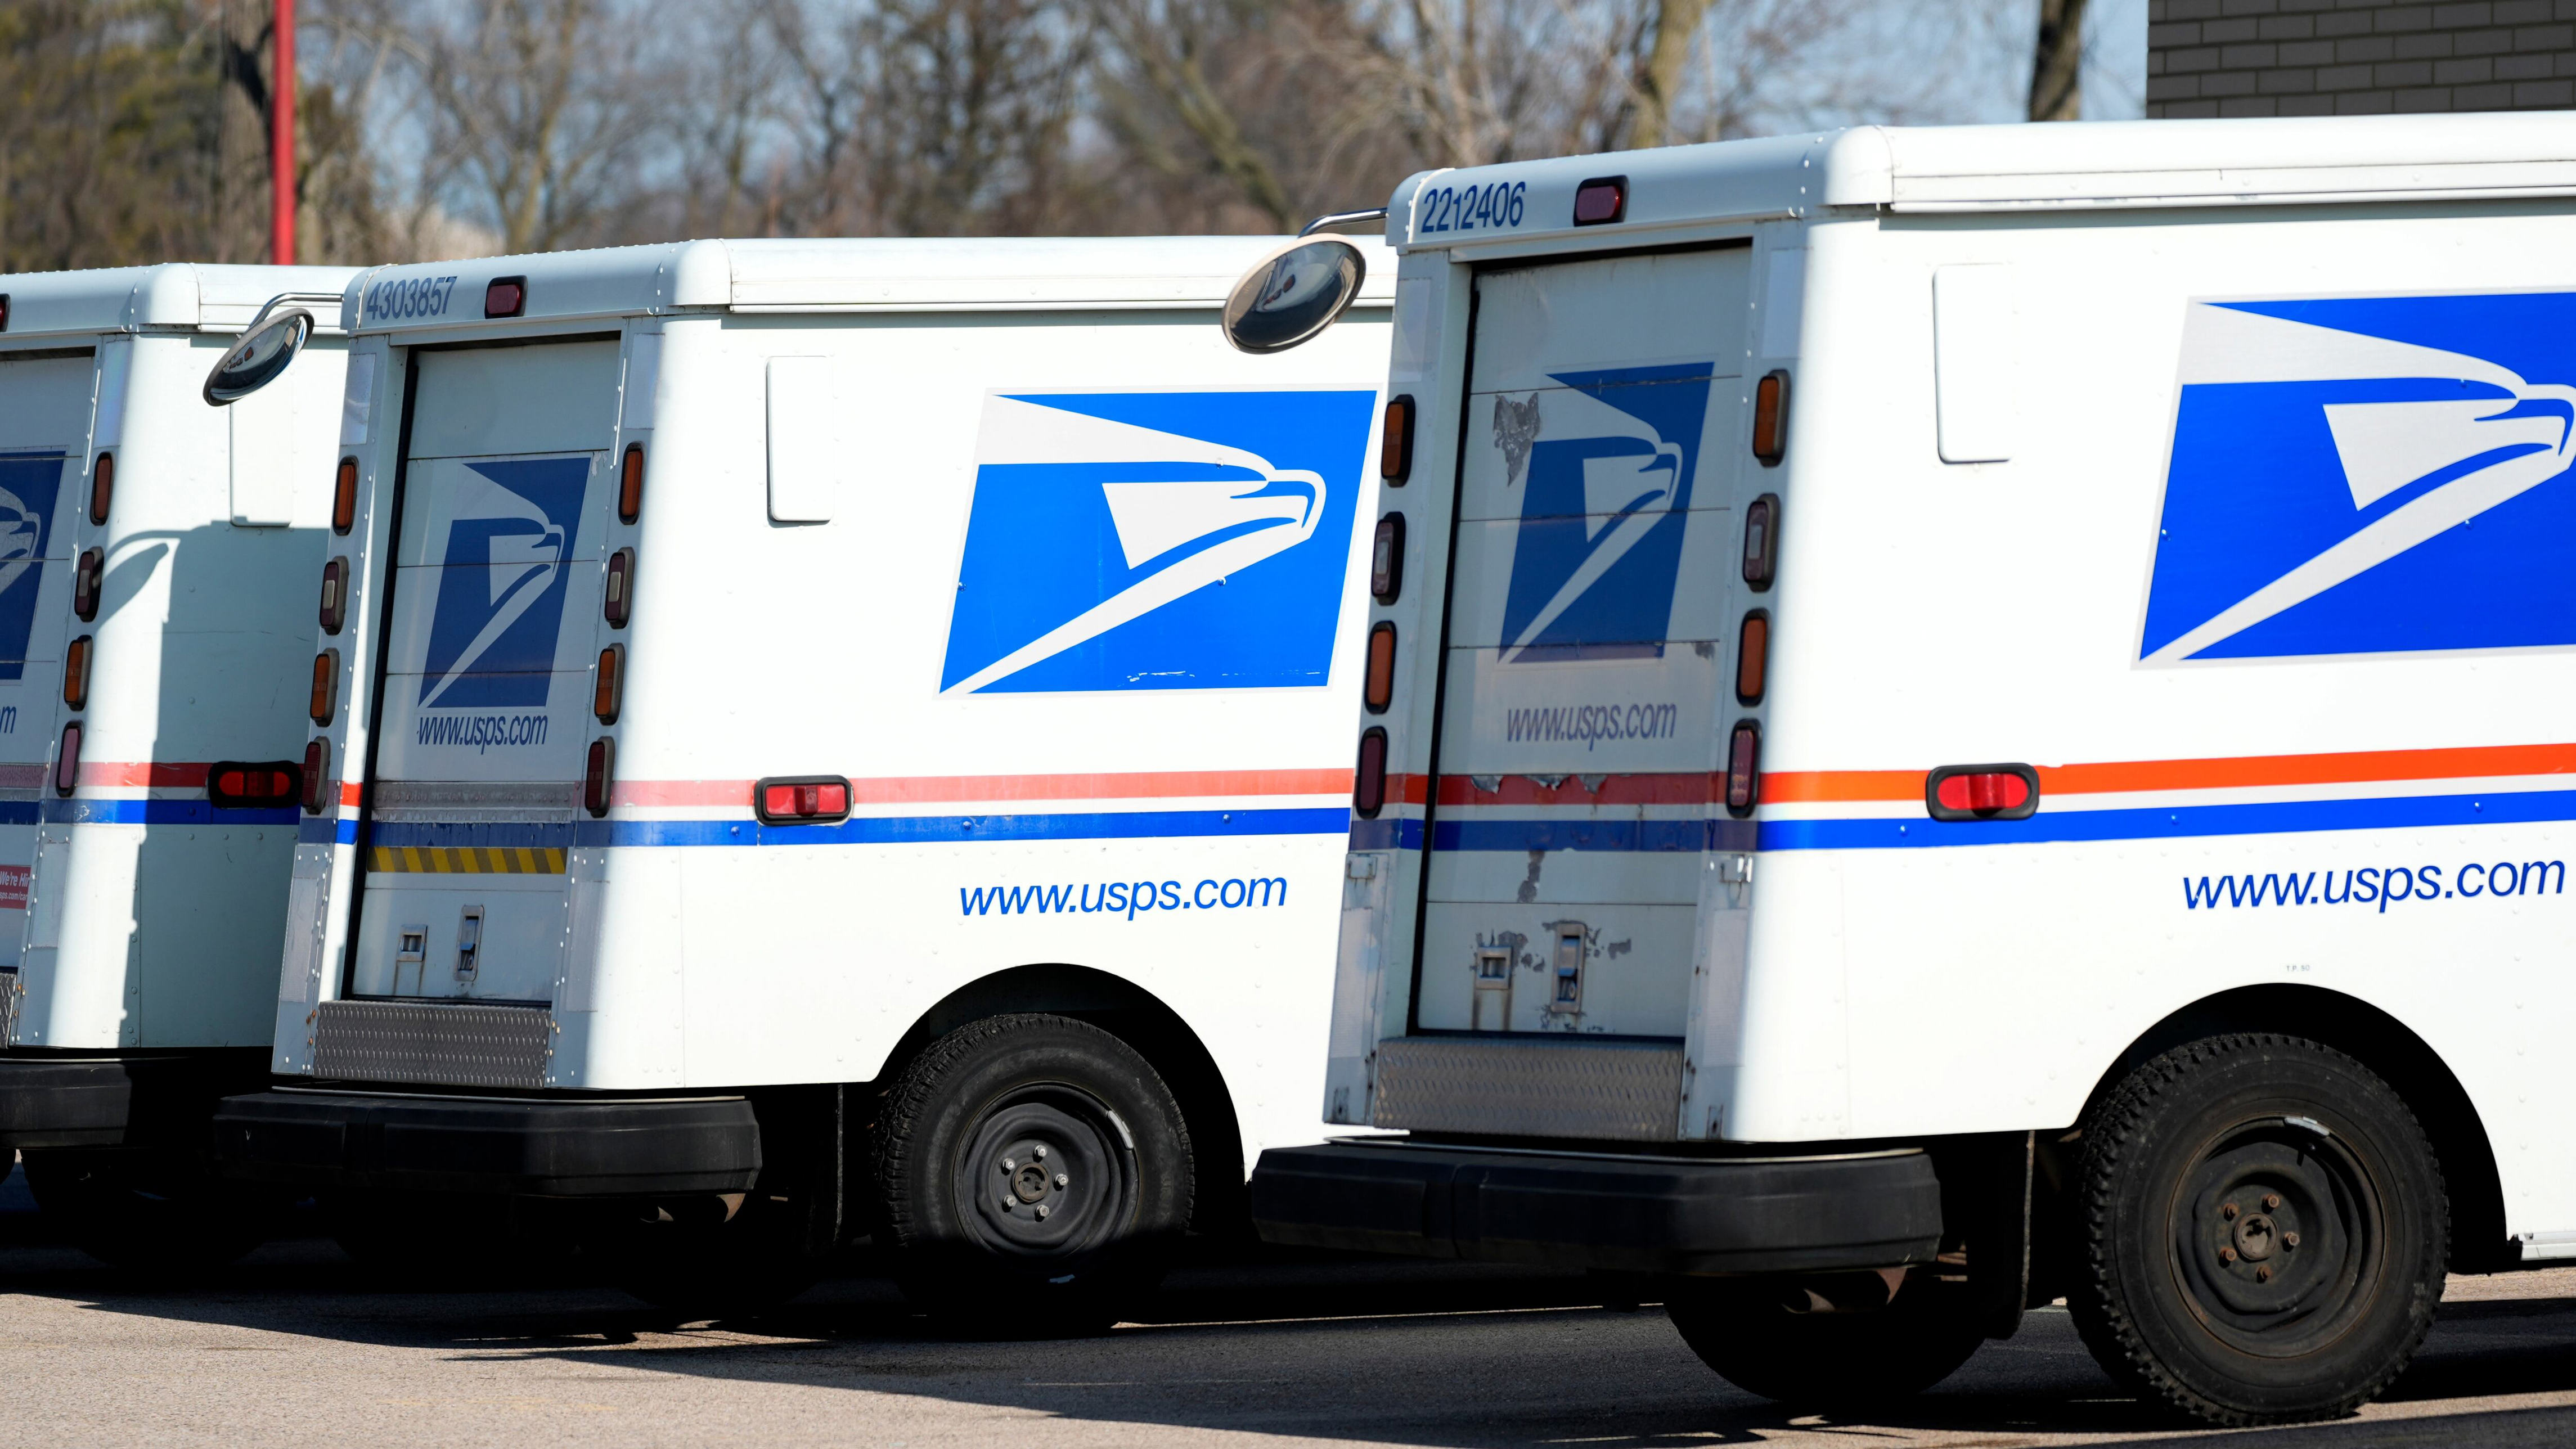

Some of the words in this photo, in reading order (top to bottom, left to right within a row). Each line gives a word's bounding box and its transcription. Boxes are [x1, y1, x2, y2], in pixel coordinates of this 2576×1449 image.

[1421, 181, 1526, 233] 2212406
[366, 276, 457, 320] 4303857
[419, 715, 548, 755] www.usps.com
[1508, 704, 1676, 751] www.usps.com
[960, 877, 1287, 921] www.usps.com
[2183, 860, 2565, 914] www.usps.com
